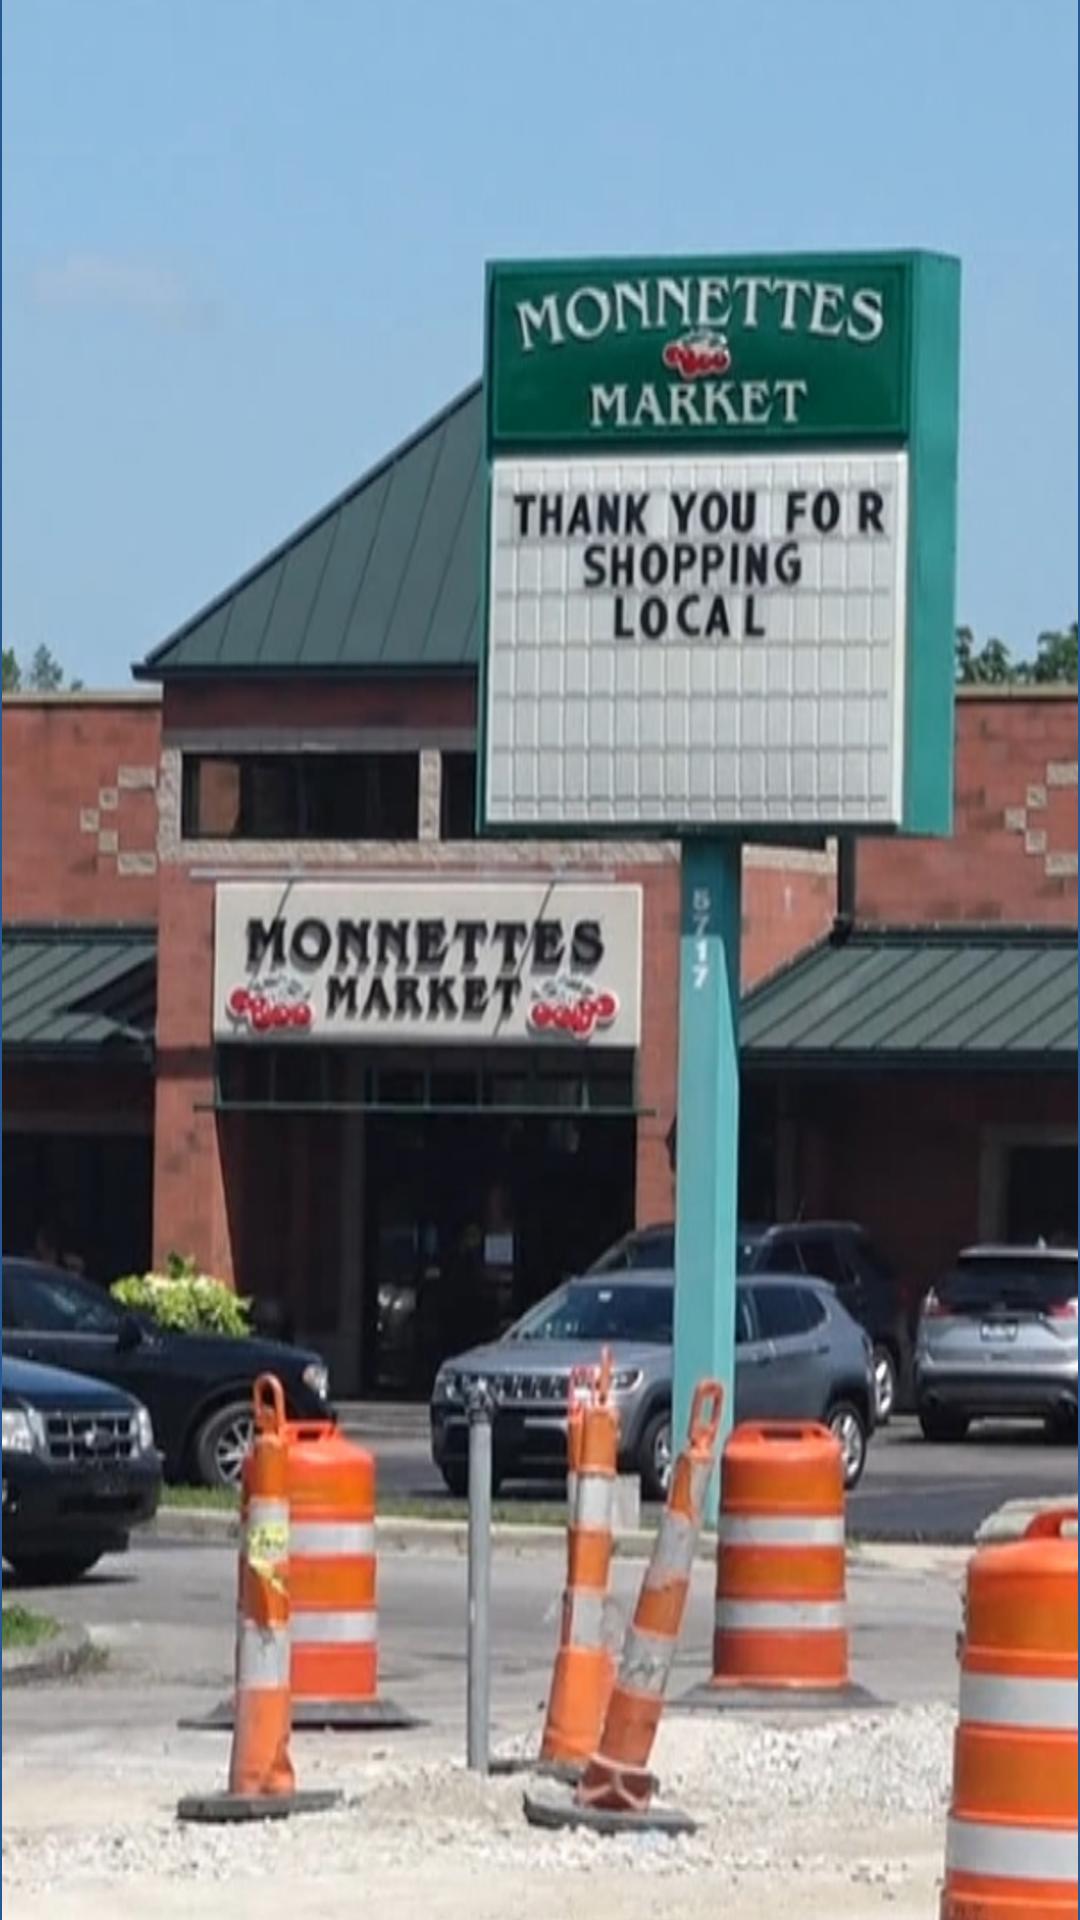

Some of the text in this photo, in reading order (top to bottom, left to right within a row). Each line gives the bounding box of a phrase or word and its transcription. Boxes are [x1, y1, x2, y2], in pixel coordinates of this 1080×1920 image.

[517, 276, 884, 351] MONNETTES
[590, 380, 807, 427] MARKET
[514, 490, 885, 536] THANK YOU FOR
[584, 543, 802, 587] SHOPPING
[614, 595, 766, 639] LOCAL
[246, 918, 605, 967] MONNETTES
[692, 888, 711, 990] 5717
[325, 976, 521, 1017] MARKET
